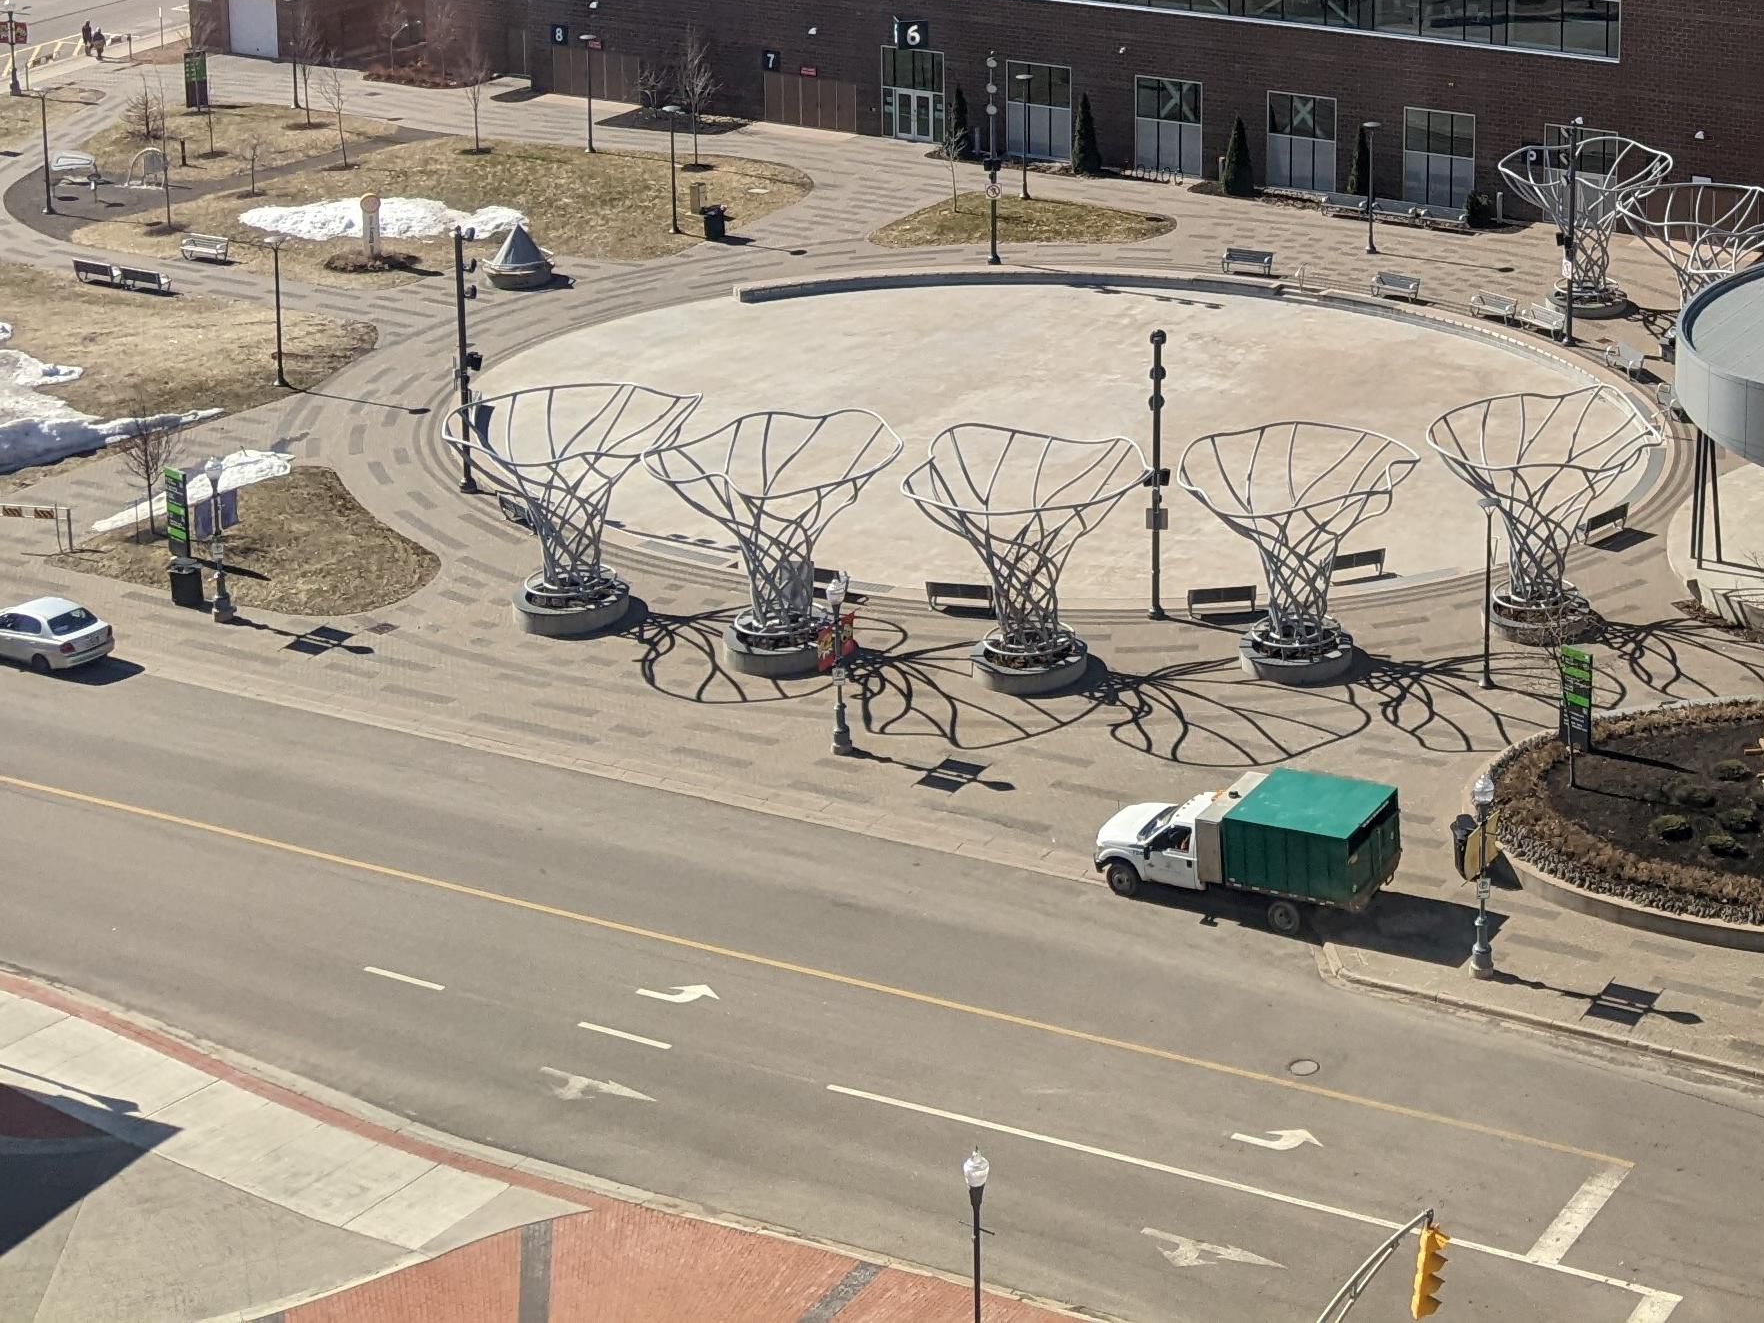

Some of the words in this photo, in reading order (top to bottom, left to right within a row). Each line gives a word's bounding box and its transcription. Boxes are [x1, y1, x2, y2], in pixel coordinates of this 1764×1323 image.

[555, 27, 563, 42] 8
[906, 24, 921, 46] 6
[766, 53, 775, 69] 7
